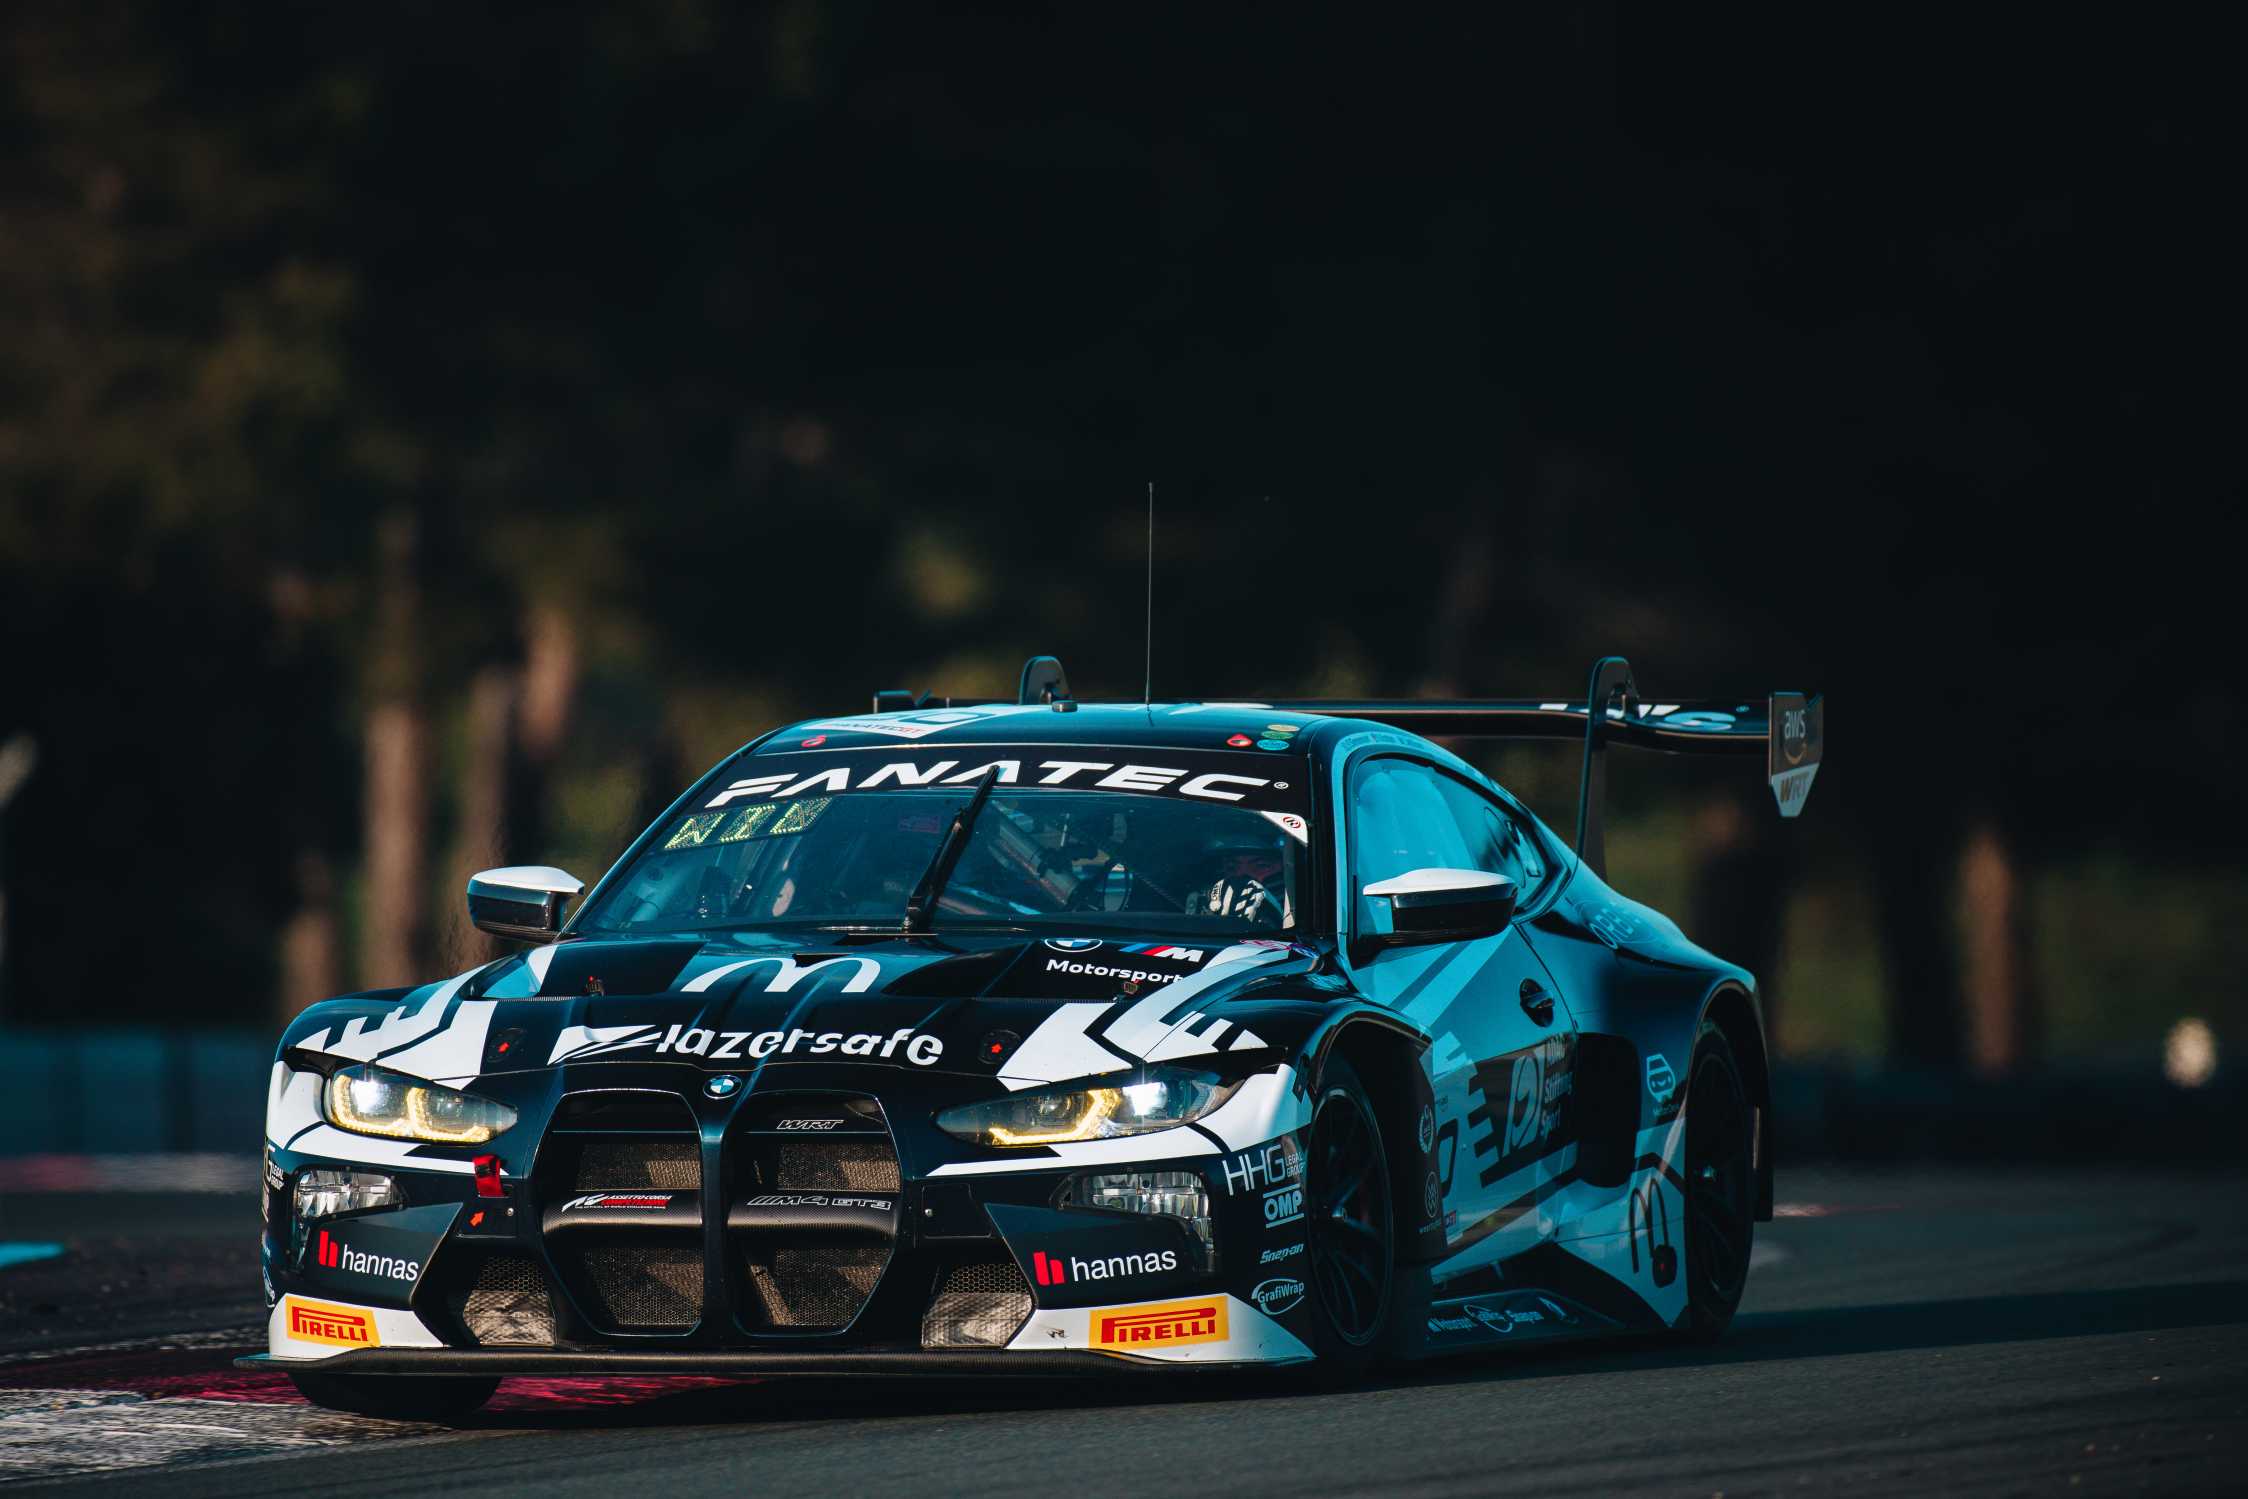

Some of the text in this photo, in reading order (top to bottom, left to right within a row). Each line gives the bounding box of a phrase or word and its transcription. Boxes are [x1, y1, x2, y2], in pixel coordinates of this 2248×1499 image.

[1785, 709, 1806, 739] aws
[705, 759, 1271, 807] FANATEC
[1046, 959, 1184, 984] Motorsport
[656, 1024, 943, 1066] lazersafe
[776, 1119, 844, 1131] WRT
[1222, 1144, 1286, 1197] HHG
[1264, 1190, 1304, 1222] OMP
[341, 1244, 420, 1282] hannas
[1071, 1250, 1177, 1282] hannas
[1257, 1280, 1305, 1305] GrafiWrap
[292, 1306, 368, 1342] PIRELLI
[1101, 1307, 1217, 1344] PIRELLI
